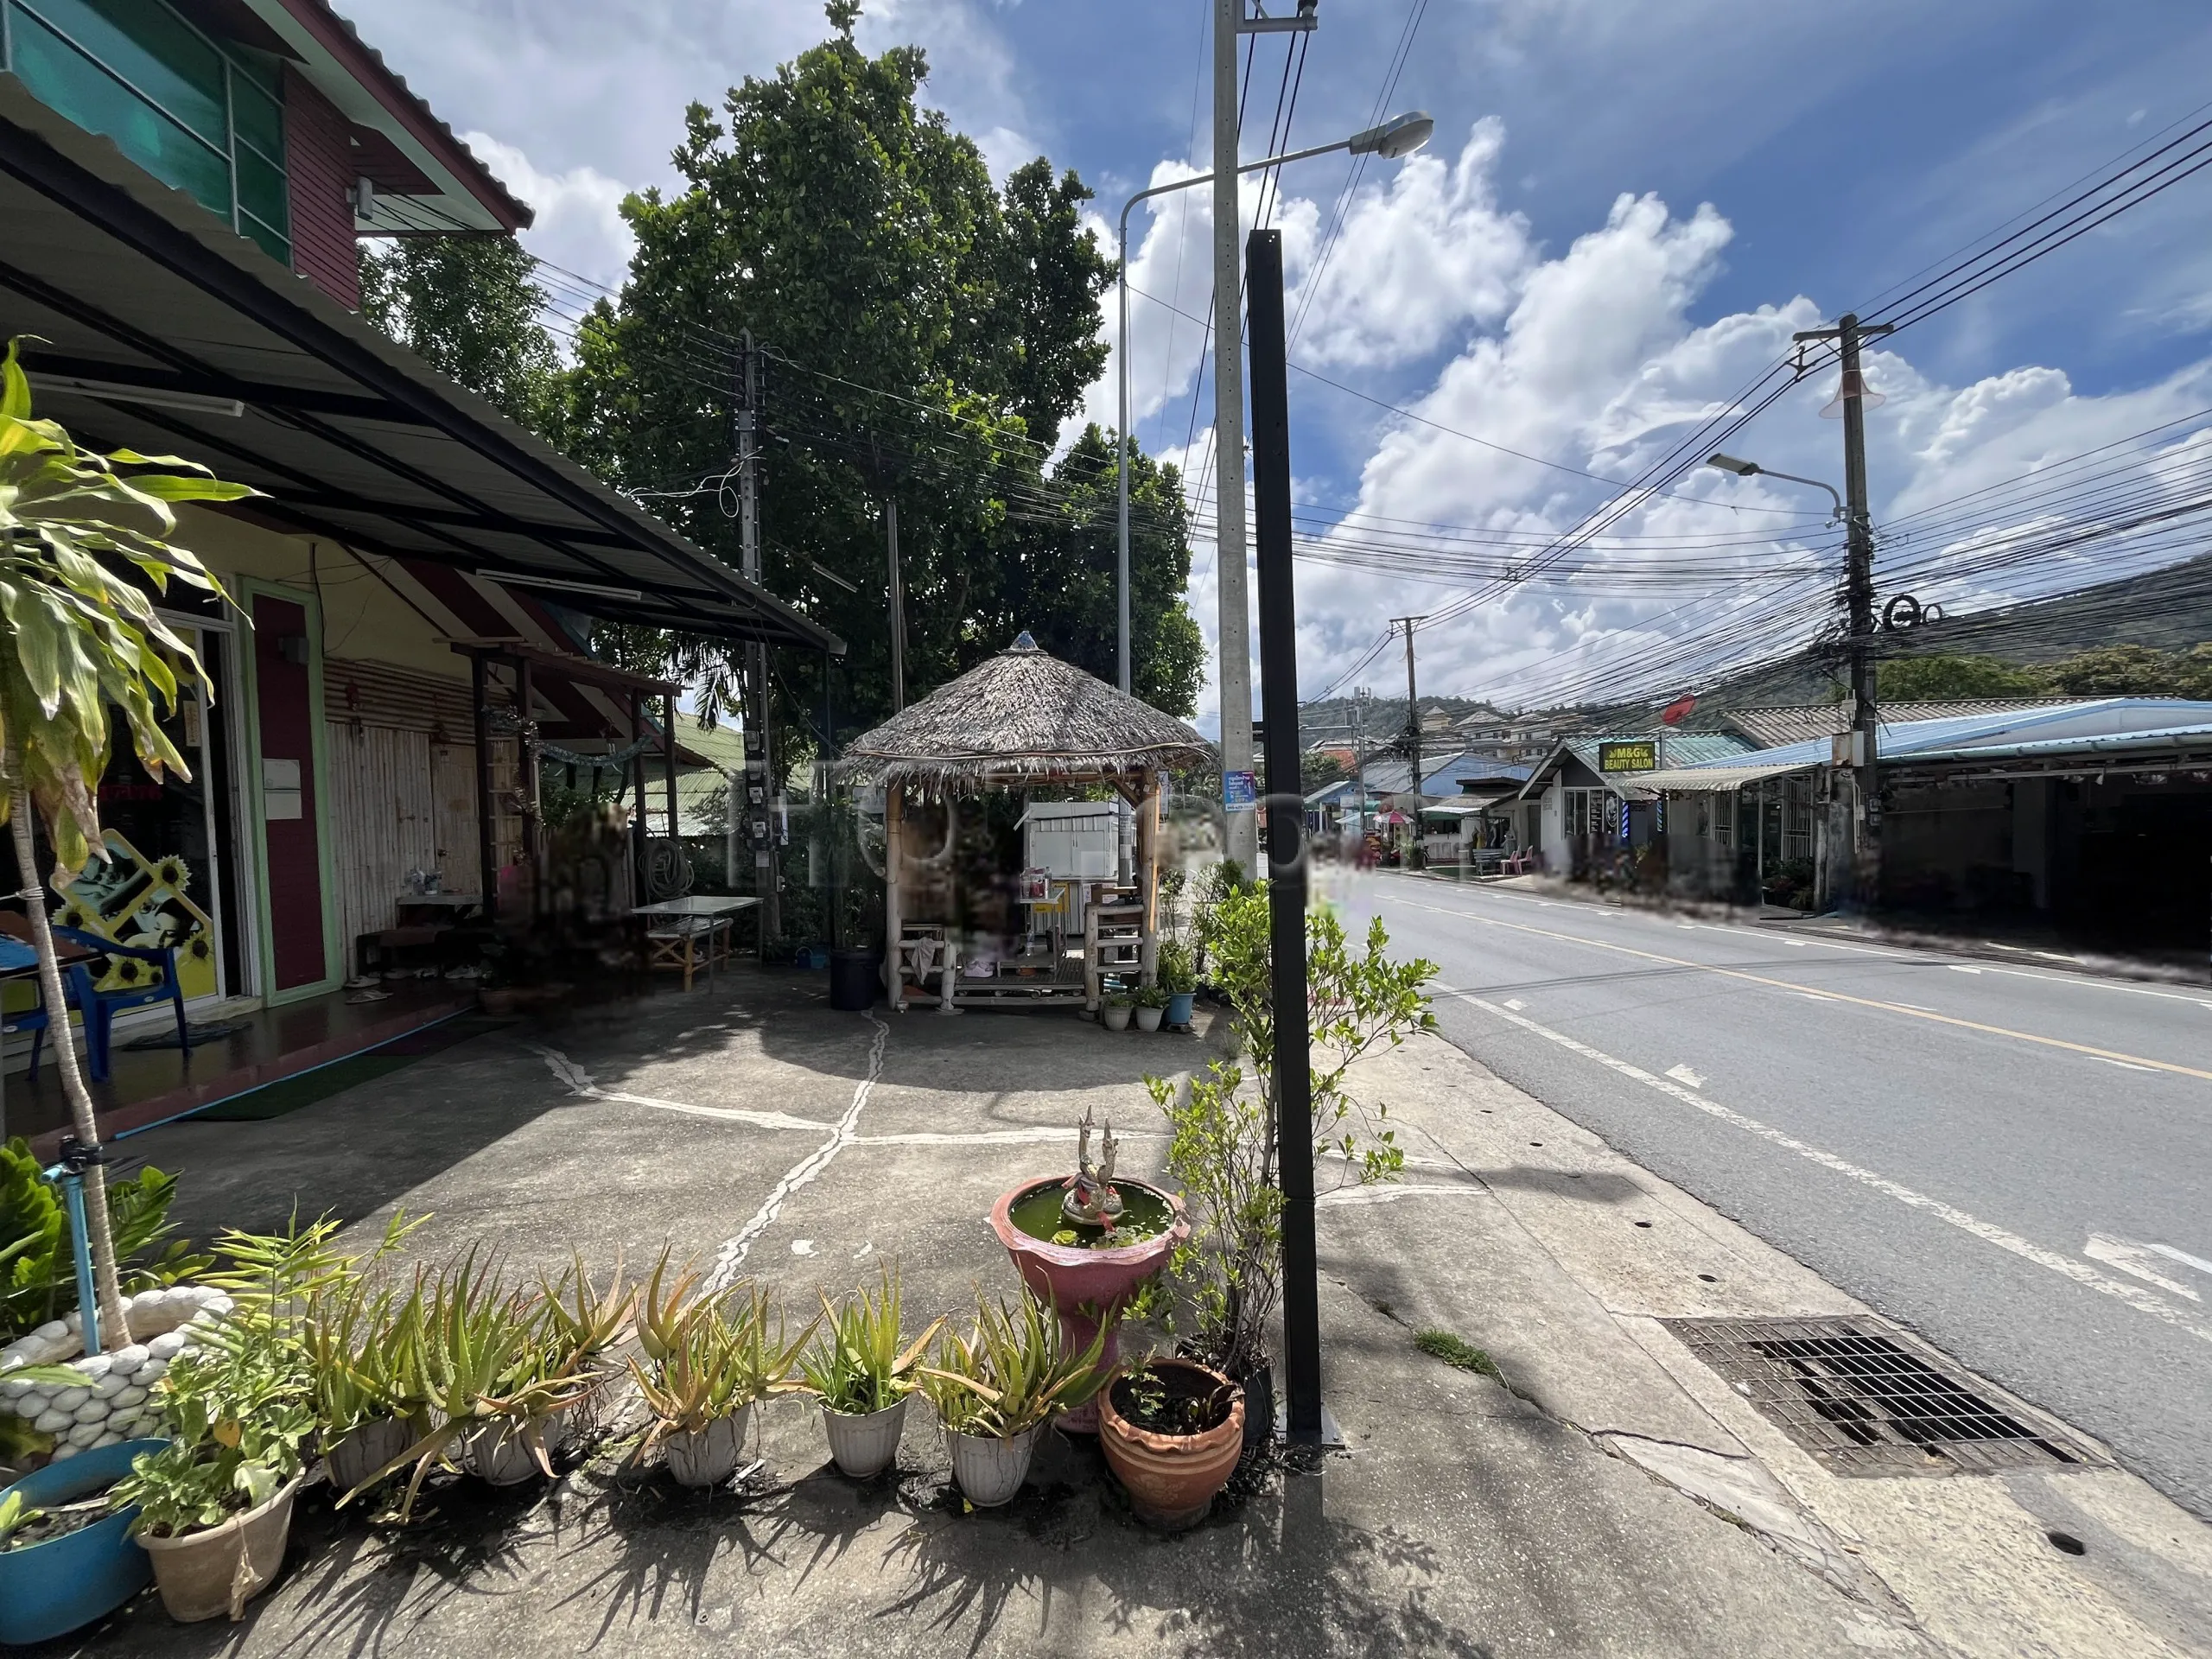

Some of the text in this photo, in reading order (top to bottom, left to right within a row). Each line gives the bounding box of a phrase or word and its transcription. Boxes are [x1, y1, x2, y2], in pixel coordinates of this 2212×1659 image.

[1617, 747, 1640, 759] M&G
[1605, 758, 1653, 770] BEAUTY SALON
